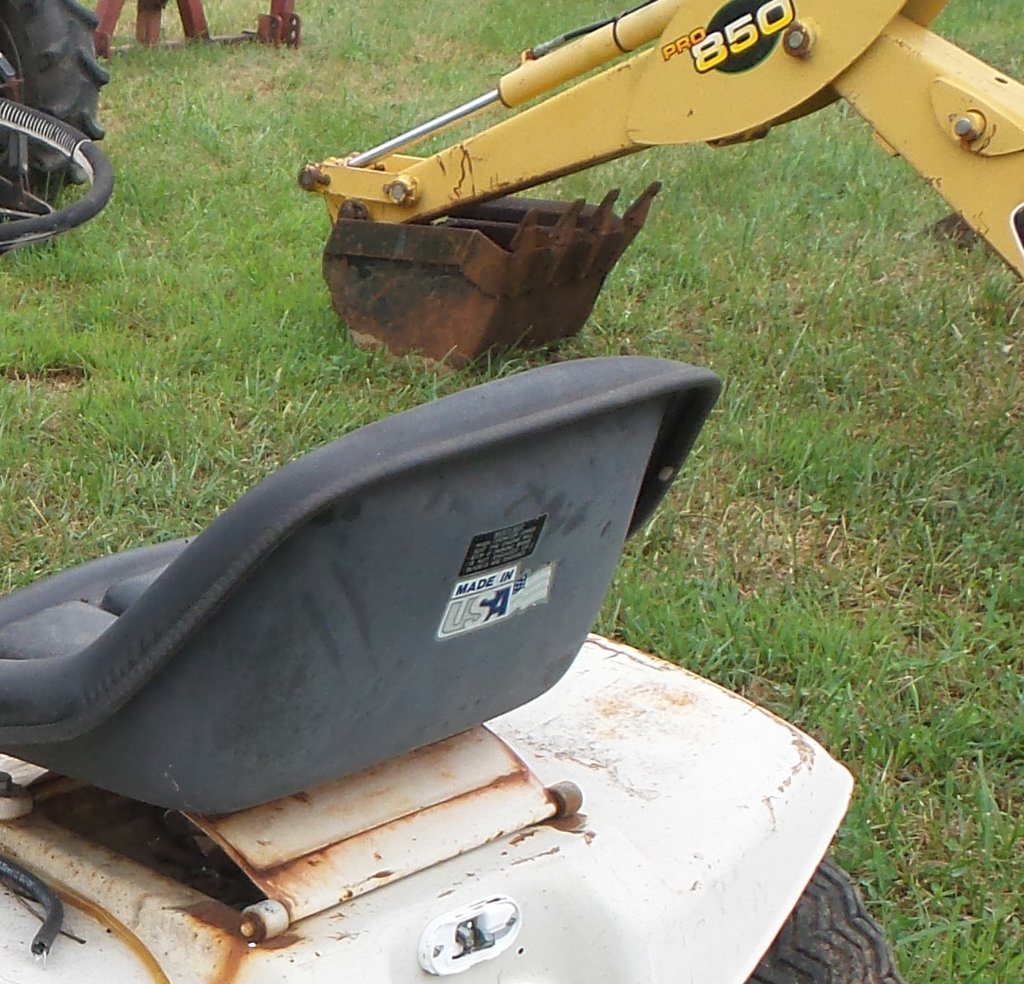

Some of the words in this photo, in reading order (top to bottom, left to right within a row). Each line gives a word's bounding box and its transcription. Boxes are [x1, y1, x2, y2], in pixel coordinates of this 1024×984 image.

[662, 27, 707, 61] PRO
[690, 0, 795, 74] 850
[456, 576, 496, 596] MADE
[500, 569, 515, 583] IN
[441, 585, 513, 635] USA
